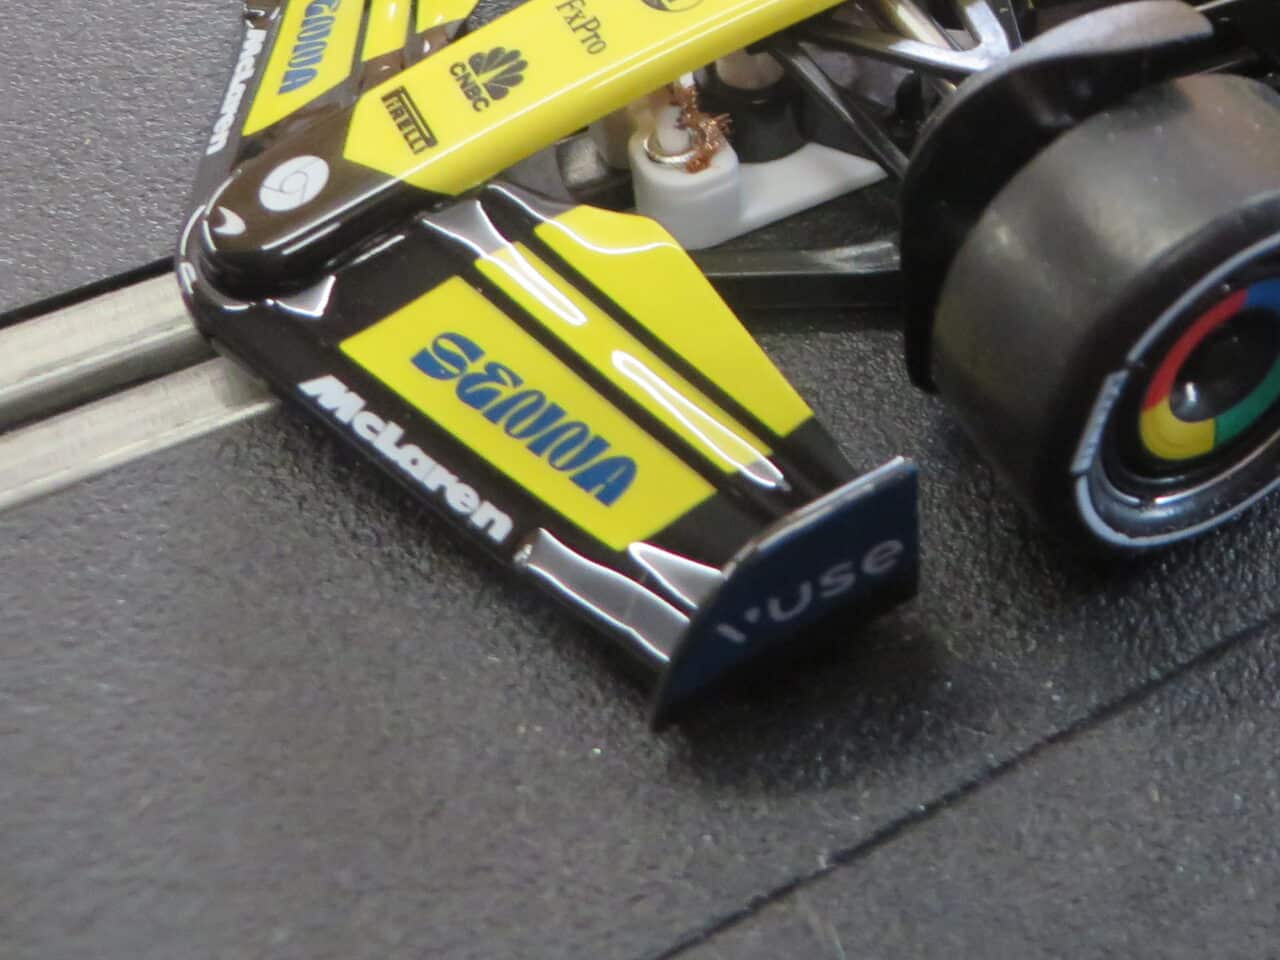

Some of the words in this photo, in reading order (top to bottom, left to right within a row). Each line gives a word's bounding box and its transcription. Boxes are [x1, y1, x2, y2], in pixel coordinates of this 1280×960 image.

[380, 86, 439, 156] PIRELLI
[450, 61, 491, 113] CNBC
[297, 373, 514, 543] McLaren
